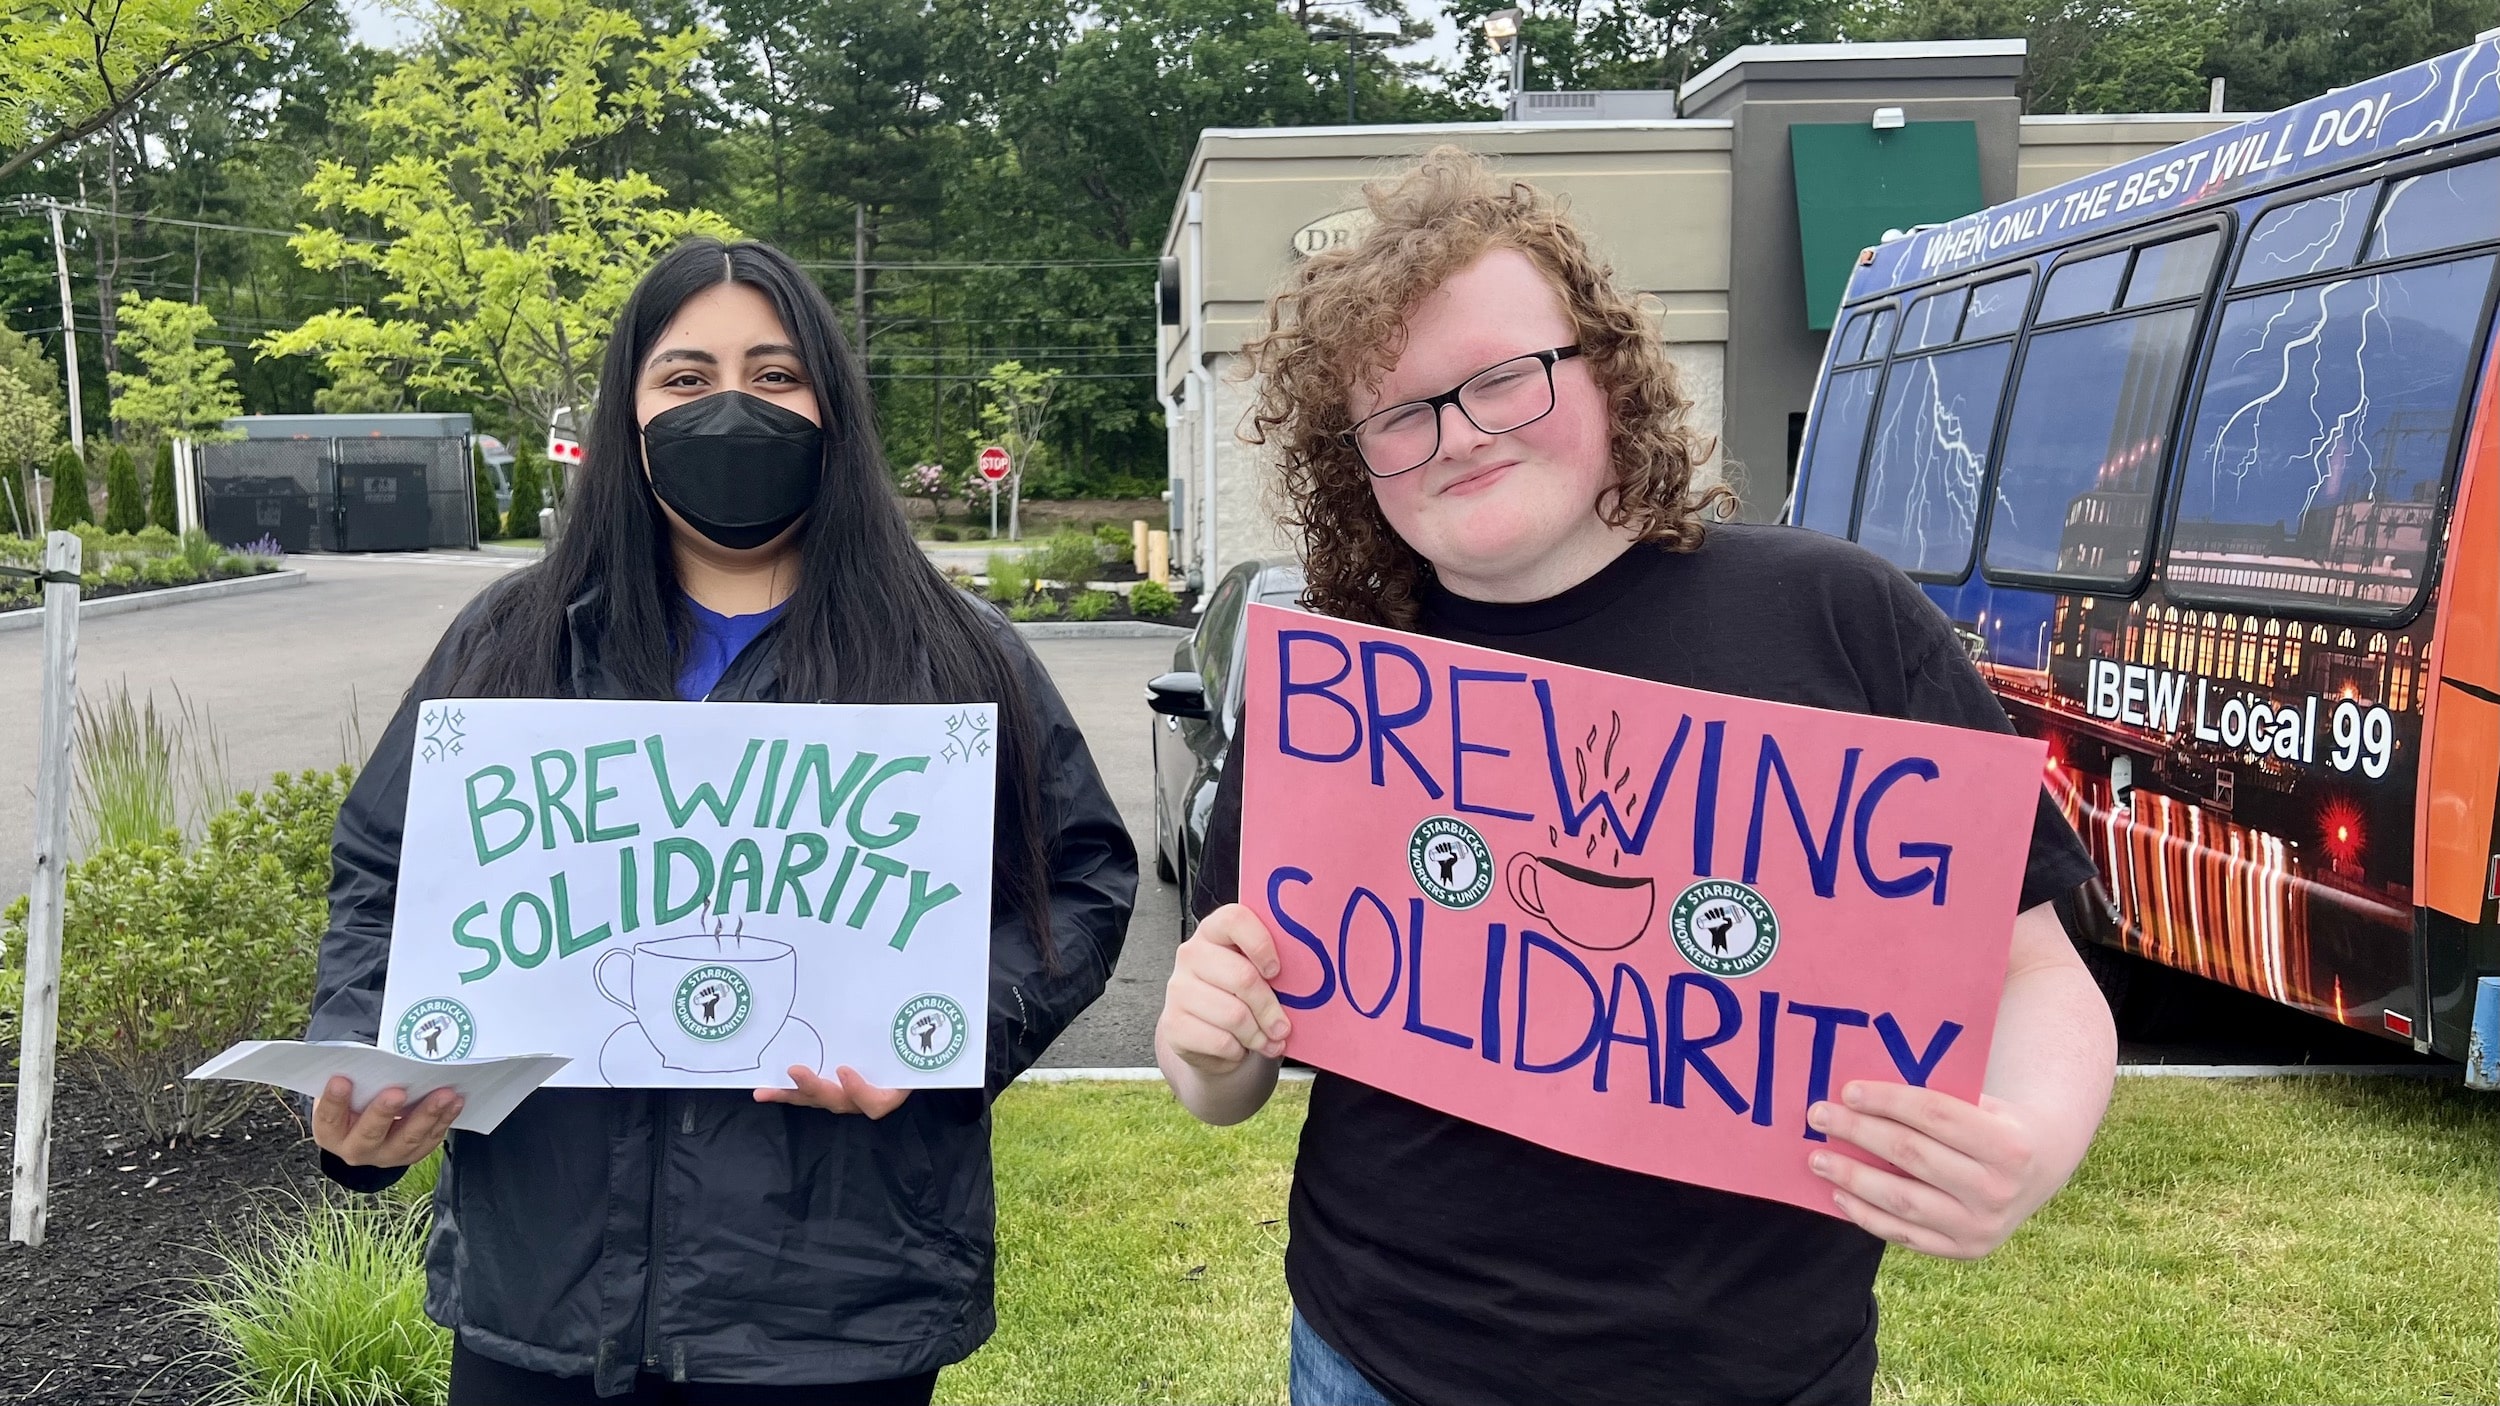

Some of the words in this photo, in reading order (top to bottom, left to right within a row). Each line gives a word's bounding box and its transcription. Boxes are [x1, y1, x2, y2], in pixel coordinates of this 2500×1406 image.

[1921, 222, 1991, 270] WHEN
[1988, 199, 2059, 250] ONLY
[2058, 180, 2118, 229] THE
[2115, 150, 2209, 213] BEST
[2208, 124, 2294, 185] WILL
[2303, 92, 2391, 157] DO!
[982, 457, 1008, 471] STOP
[2086, 658, 2187, 734] IBEW
[2195, 678, 2317, 763] Local
[2331, 698, 2392, 779] 99
[1279, 630, 1951, 905] BREWING
[465, 733, 930, 867] BREWING
[1422, 821, 1486, 858] STARBUCKS
[1411, 848, 1446, 900] WORKERS
[1456, 873, 1489, 904] UNITED
[452, 835, 961, 983] SOLIDARITY
[1687, 884, 1768, 920] STARBUCKS
[1674, 918, 1719, 969] WORKERS
[1733, 936, 1773, 970] UNITED
[688, 968, 745, 993] STARBUCKS
[407, 1001, 467, 1023] STARBUCKS
[677, 997, 708, 1036] WORKERS
[718, 1005, 747, 1035] UNITED
[905, 998, 961, 1022] STARBUCKS
[1267, 866, 1964, 1142] SOLIDARITY
[895, 1028, 925, 1067] WORKERS
[935, 1033, 963, 1065] UNITED
